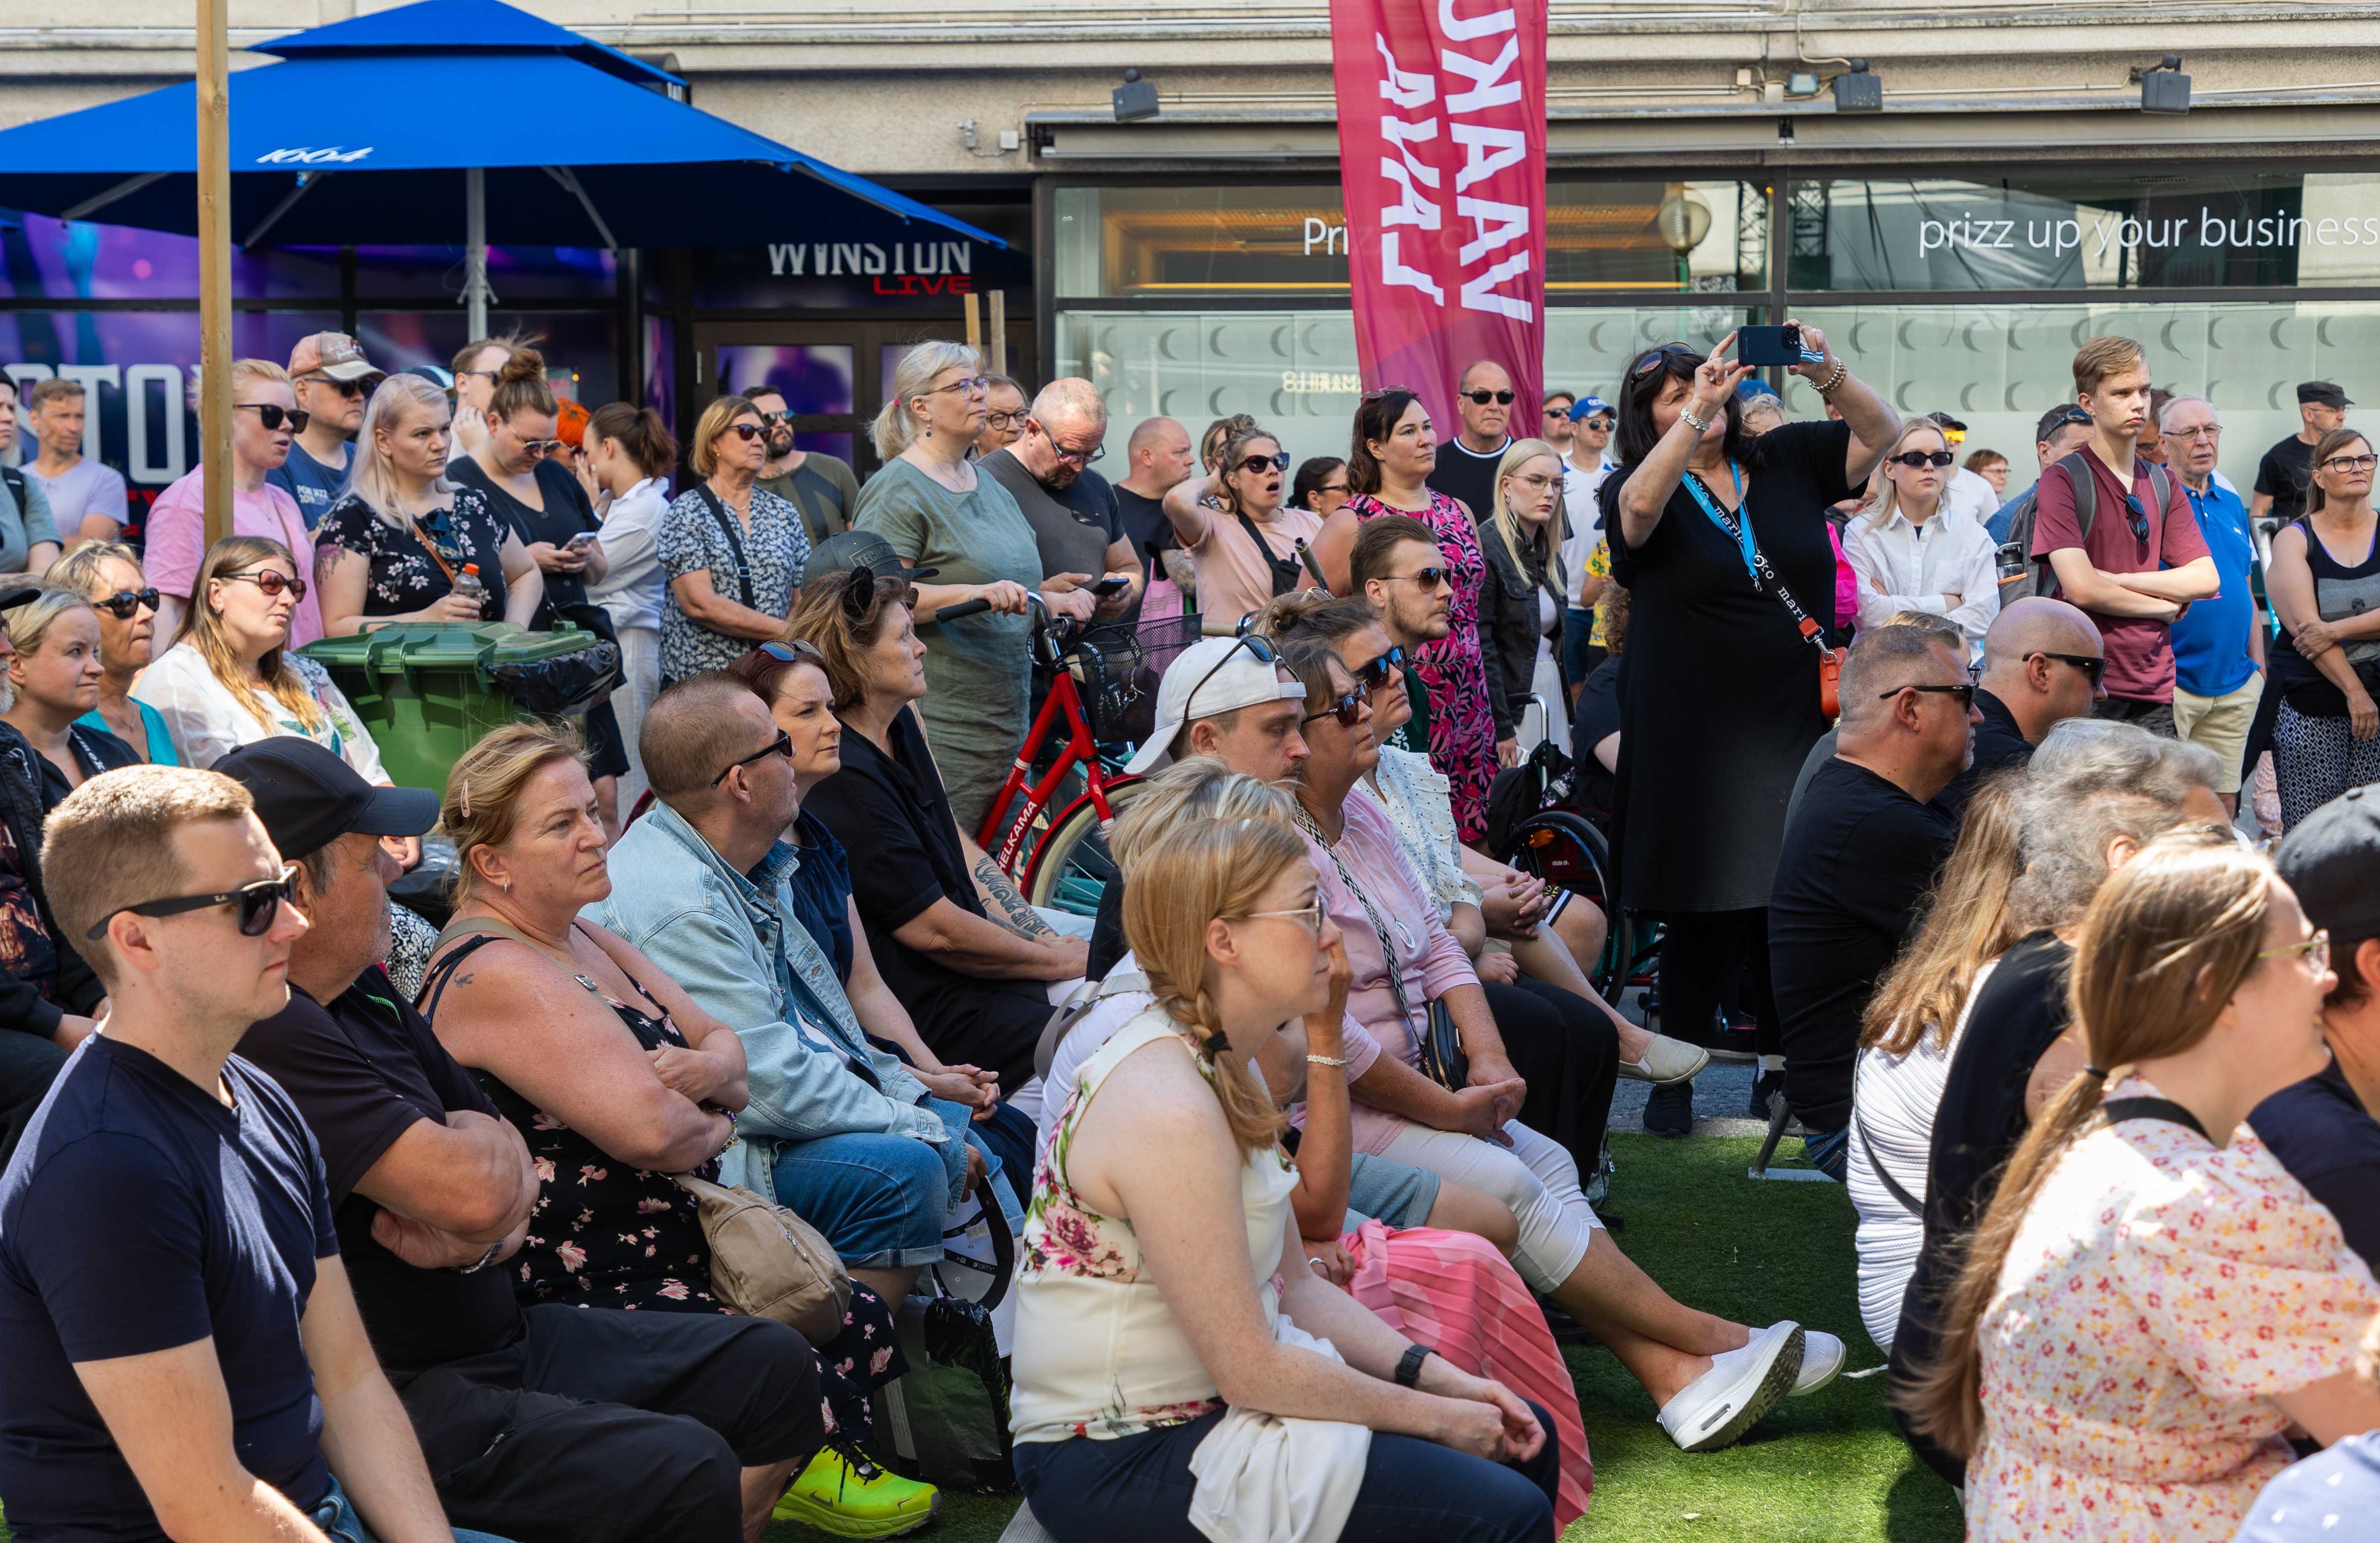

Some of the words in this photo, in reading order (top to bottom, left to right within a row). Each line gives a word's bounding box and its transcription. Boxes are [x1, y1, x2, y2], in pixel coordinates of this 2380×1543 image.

[1919, 212, 2014, 258] prizz
[2028, 219, 2081, 258] up
[2094, 218, 2188, 258] your
[2201, 207, 2379, 247] business
[768, 241, 970, 275] WINSTON
[873, 276, 971, 294] LIVE
